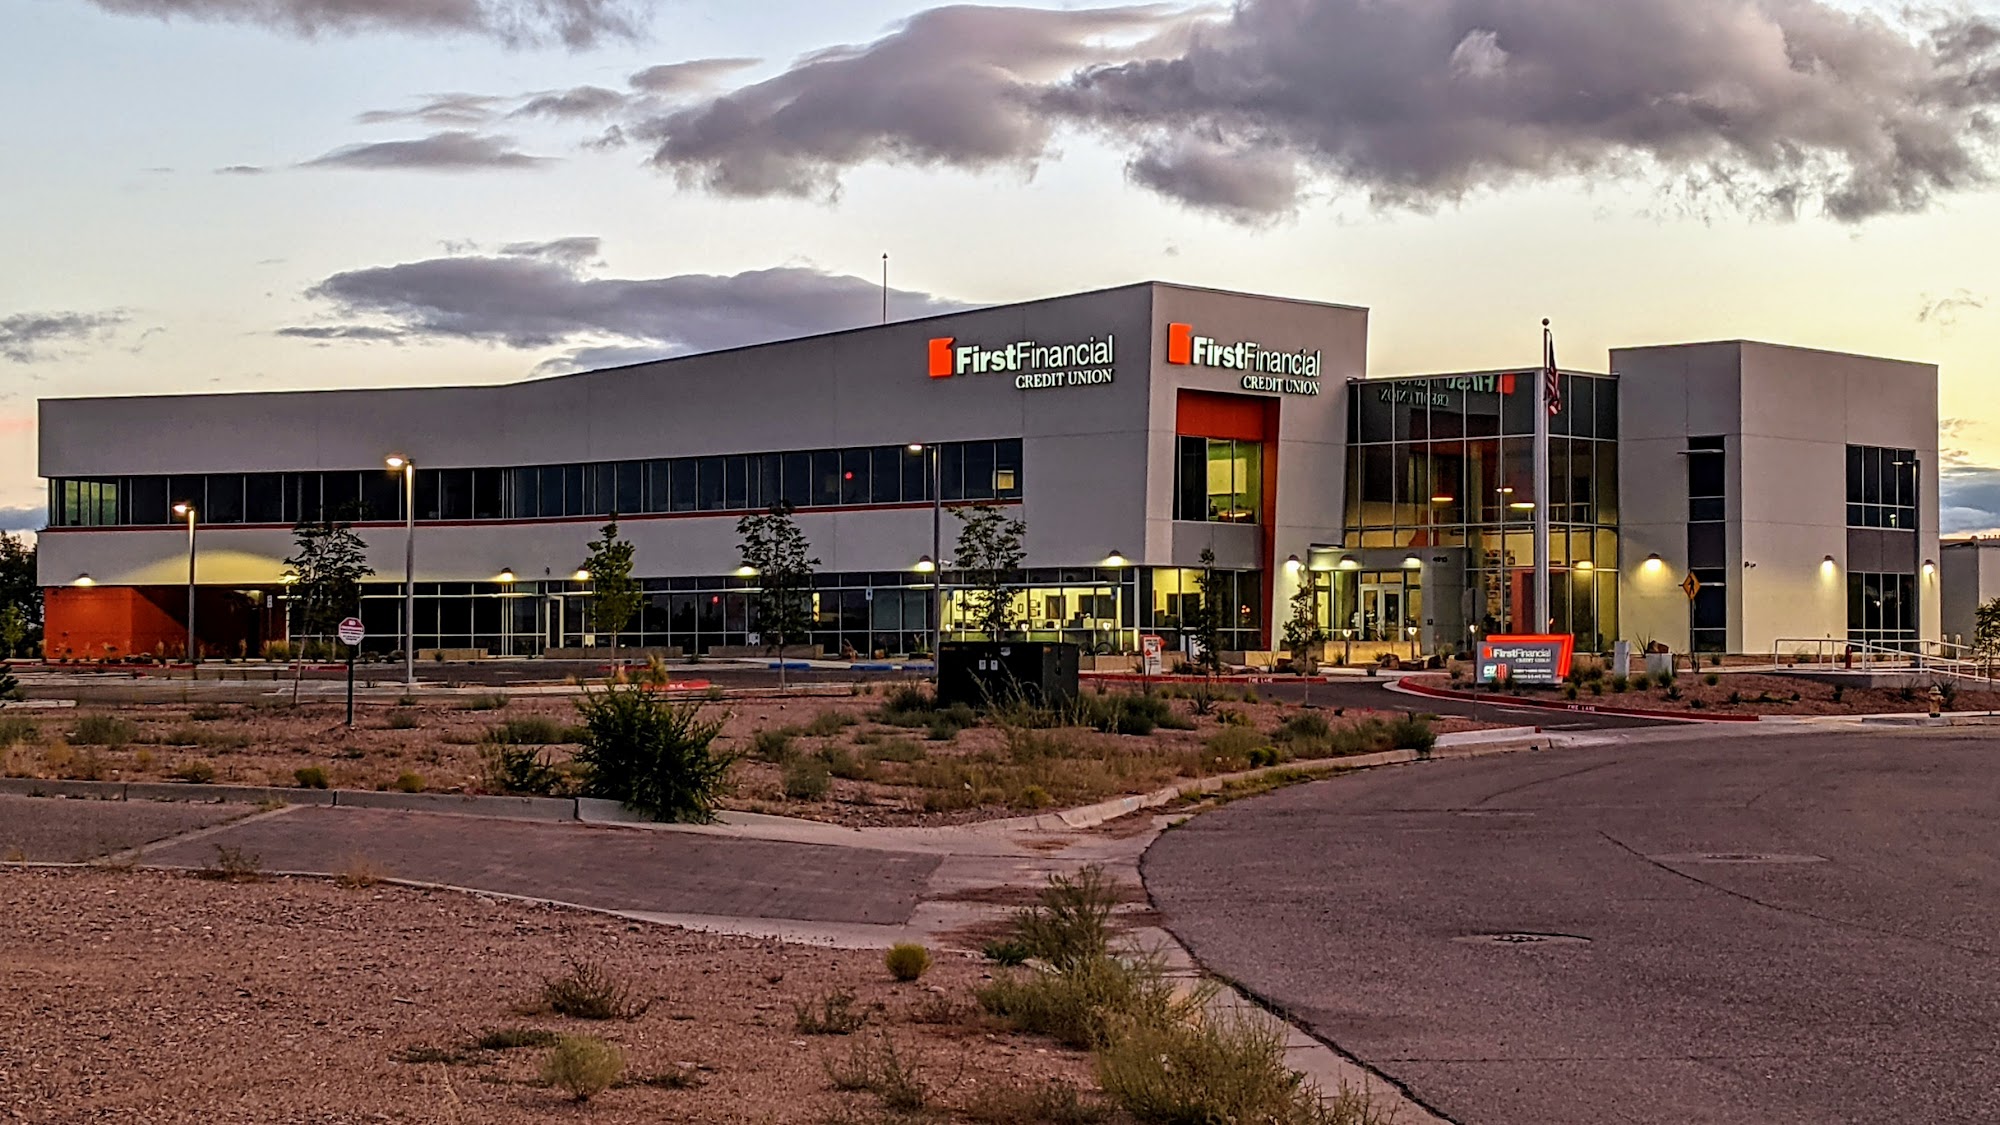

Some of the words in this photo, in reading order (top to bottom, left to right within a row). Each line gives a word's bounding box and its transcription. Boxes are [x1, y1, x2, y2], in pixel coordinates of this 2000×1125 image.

[956, 334, 1114, 374] FirstFinancial
[1192, 336, 1321, 377] FirstFinancial
[1015, 373, 1064, 389] CREDIT
[1067, 368, 1113, 385] UNION
[1243, 375, 1284, 392] CREDIT
[1285, 380, 1320, 395] UNION
[1493, 648, 1551, 658] FirstFinancial
